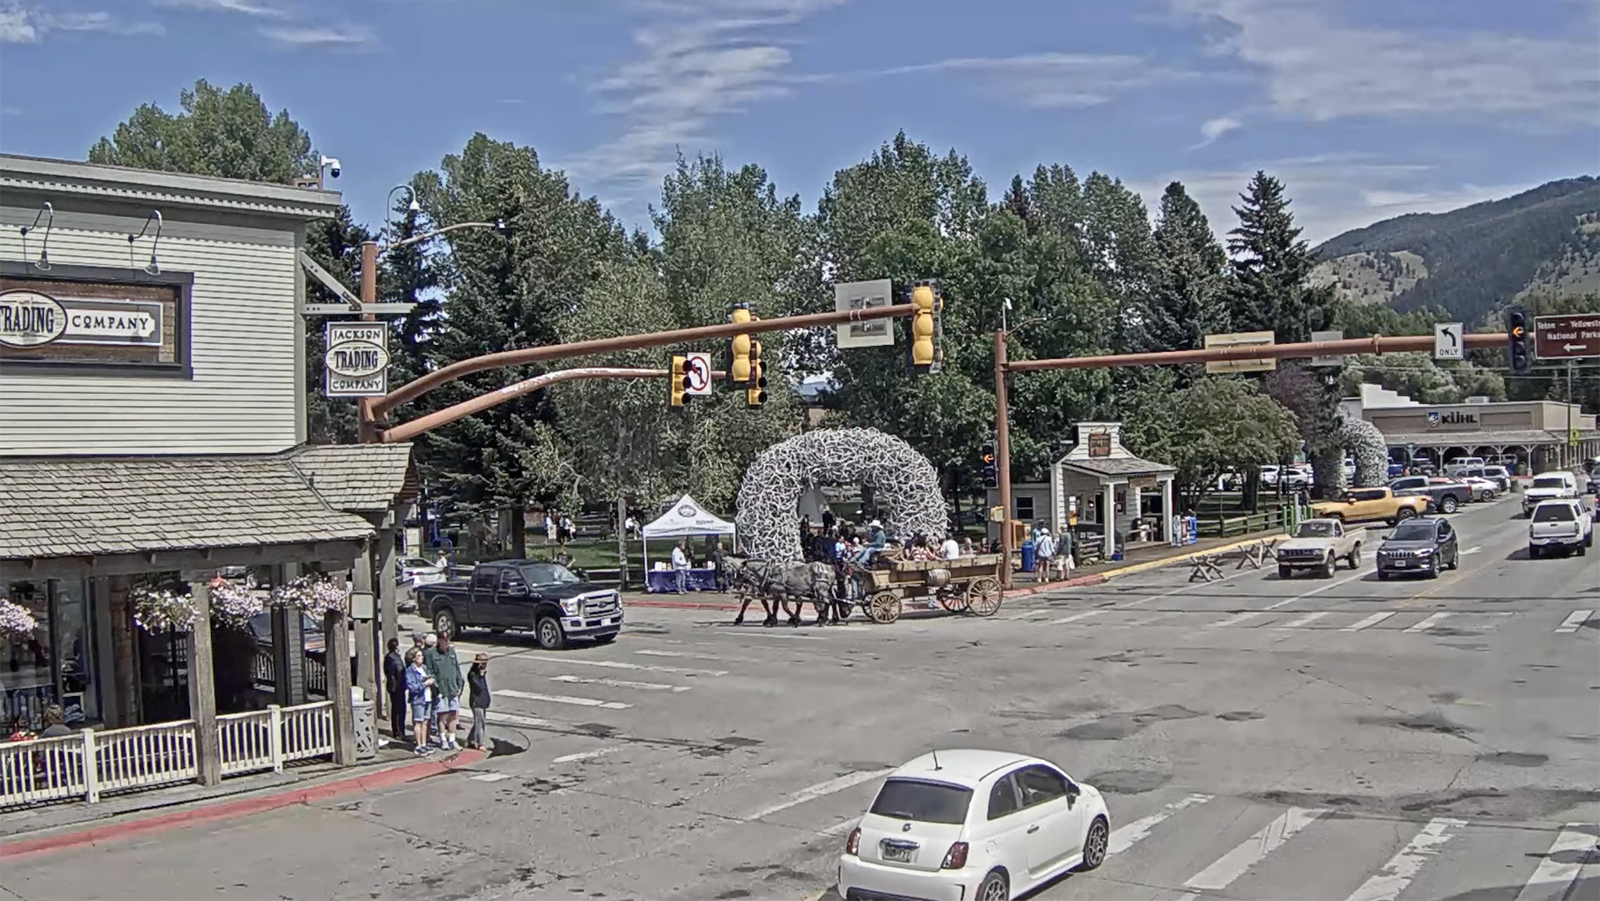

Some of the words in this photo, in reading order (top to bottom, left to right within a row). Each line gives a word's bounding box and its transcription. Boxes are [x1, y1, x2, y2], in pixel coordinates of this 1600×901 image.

[72, 315, 148, 330] COMPANY
[1537, 321, 1556, 329] Teton
[334, 330, 380, 340] JACKSON
[1547, 332, 1577, 340] National
[1439, 348, 1458, 356] ONLY
[334, 350, 378, 369] TRADING
[332, 380, 381, 389] COMPANY
[1441, 411, 1478, 424] KÜHL
